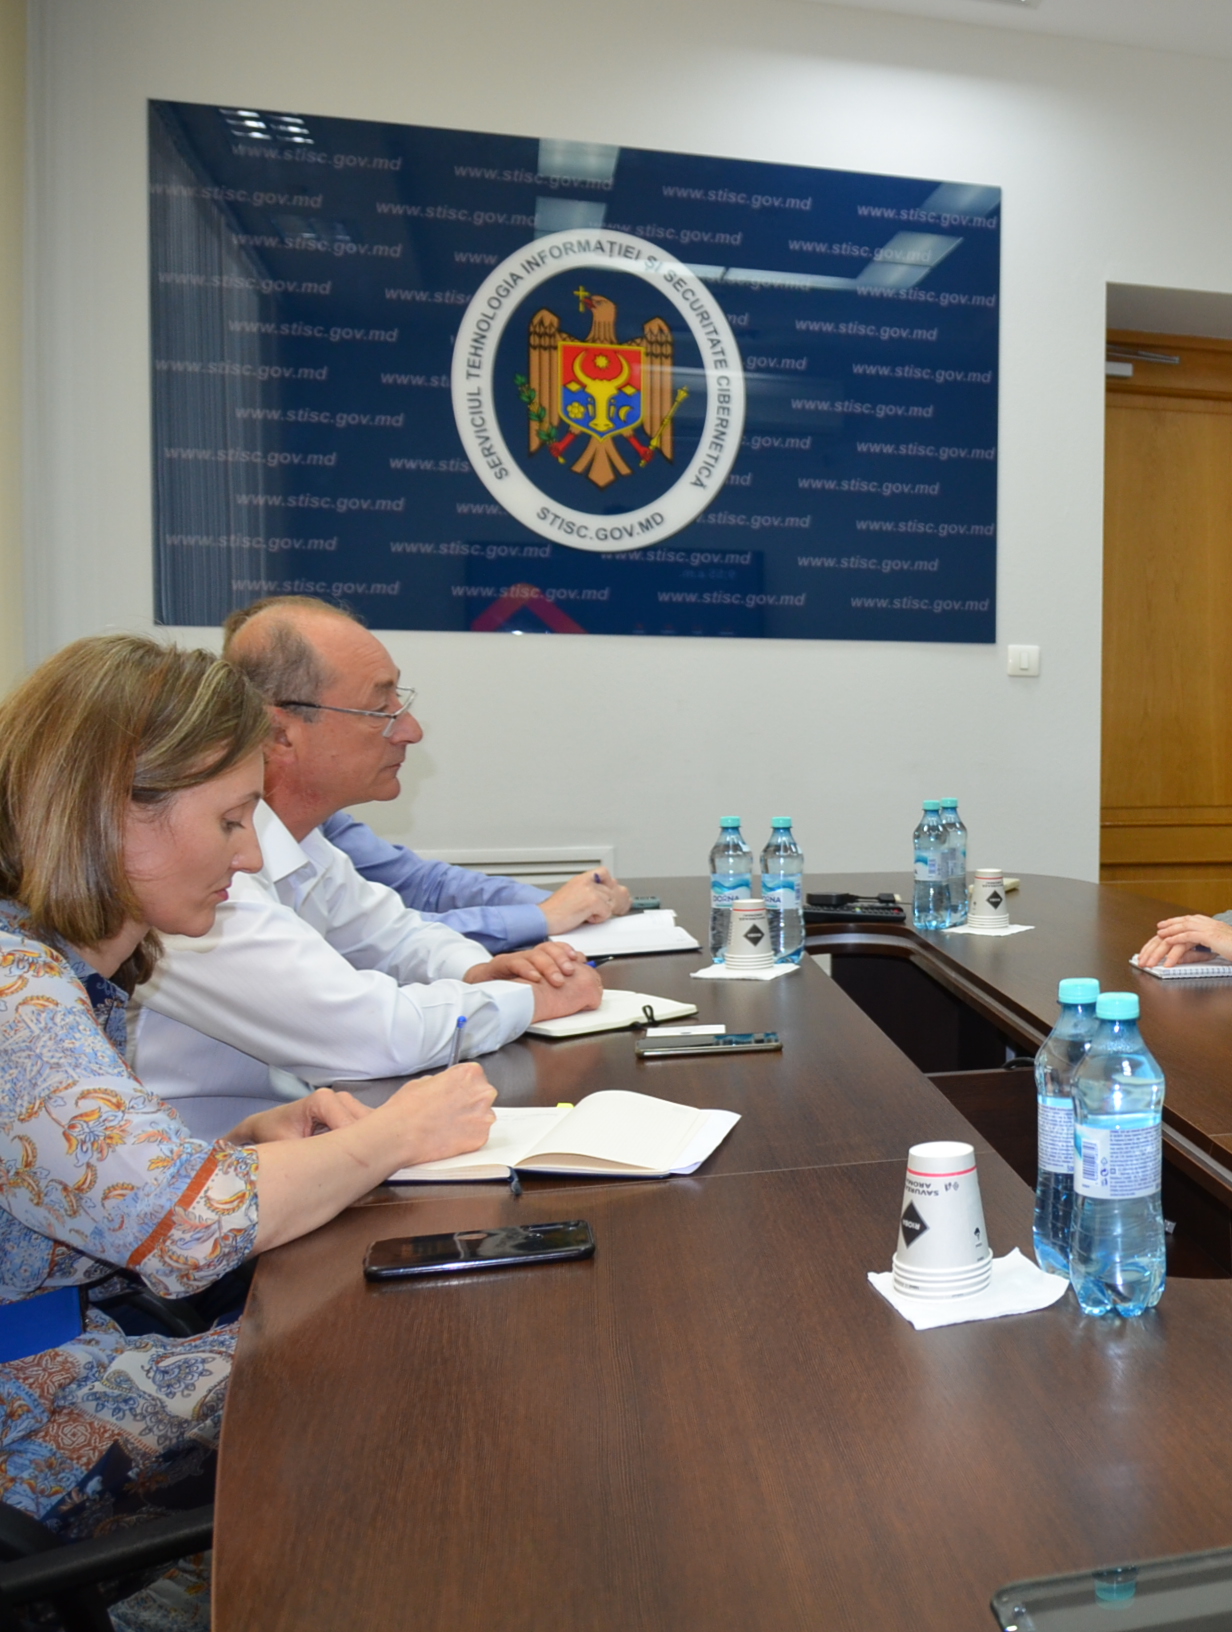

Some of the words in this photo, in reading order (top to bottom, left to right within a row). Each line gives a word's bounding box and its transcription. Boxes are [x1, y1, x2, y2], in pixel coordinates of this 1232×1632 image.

[231, 142, 402, 172] www.stisc.gov.md
[662, 183, 812, 211] www.stisc.gov.md
[376, 200, 536, 227] www.stisc.gov.md
[857, 203, 997, 230] www.stisc.gov.md
[231, 232, 402, 259] www.stisc.gov.md
[788, 237, 931, 263] www.stisc.gov.md
[856, 283, 996, 308] www.stisc.gov.md
[227, 318, 398, 344] www.stisc.gov.md
[466, 271, 524, 380] TEHNOLOGIA
[662, 268, 730, 371] SECURITATE
[795, 316, 938, 342] www.stisc.gov.md
[154, 356, 328, 382] www.stisc.gov.md
[852, 361, 992, 385] www.stisc.gov.md
[235, 405, 404, 428] www.stisc.gov.md
[790, 396, 934, 419] www.stisc.gov.md
[466, 386, 510, 481] SERVICIUL
[164, 446, 337, 468] www.stisc.gov.md
[856, 439, 996, 461] www.stisc.gov.md
[798, 475, 940, 496] www.stisc.gov.md
[235, 492, 404, 514] www.stisc.gov.md
[536, 506, 665, 541] STISC.GOV.MD
[855, 517, 995, 537] www.stisc.gov.md
[165, 531, 338, 553] www.stisc.gov.md
[389, 539, 551, 560] www.stisc.gov.md
[797, 552, 939, 572] www.stisc.gov.md
[231, 577, 400, 597] www.stisc.gov.md
[451, 582, 610, 602] www.stisc.gov.md
[657, 588, 807, 609] www.stisc.gov.md
[850, 594, 990, 613] www.stisc.gov.md
